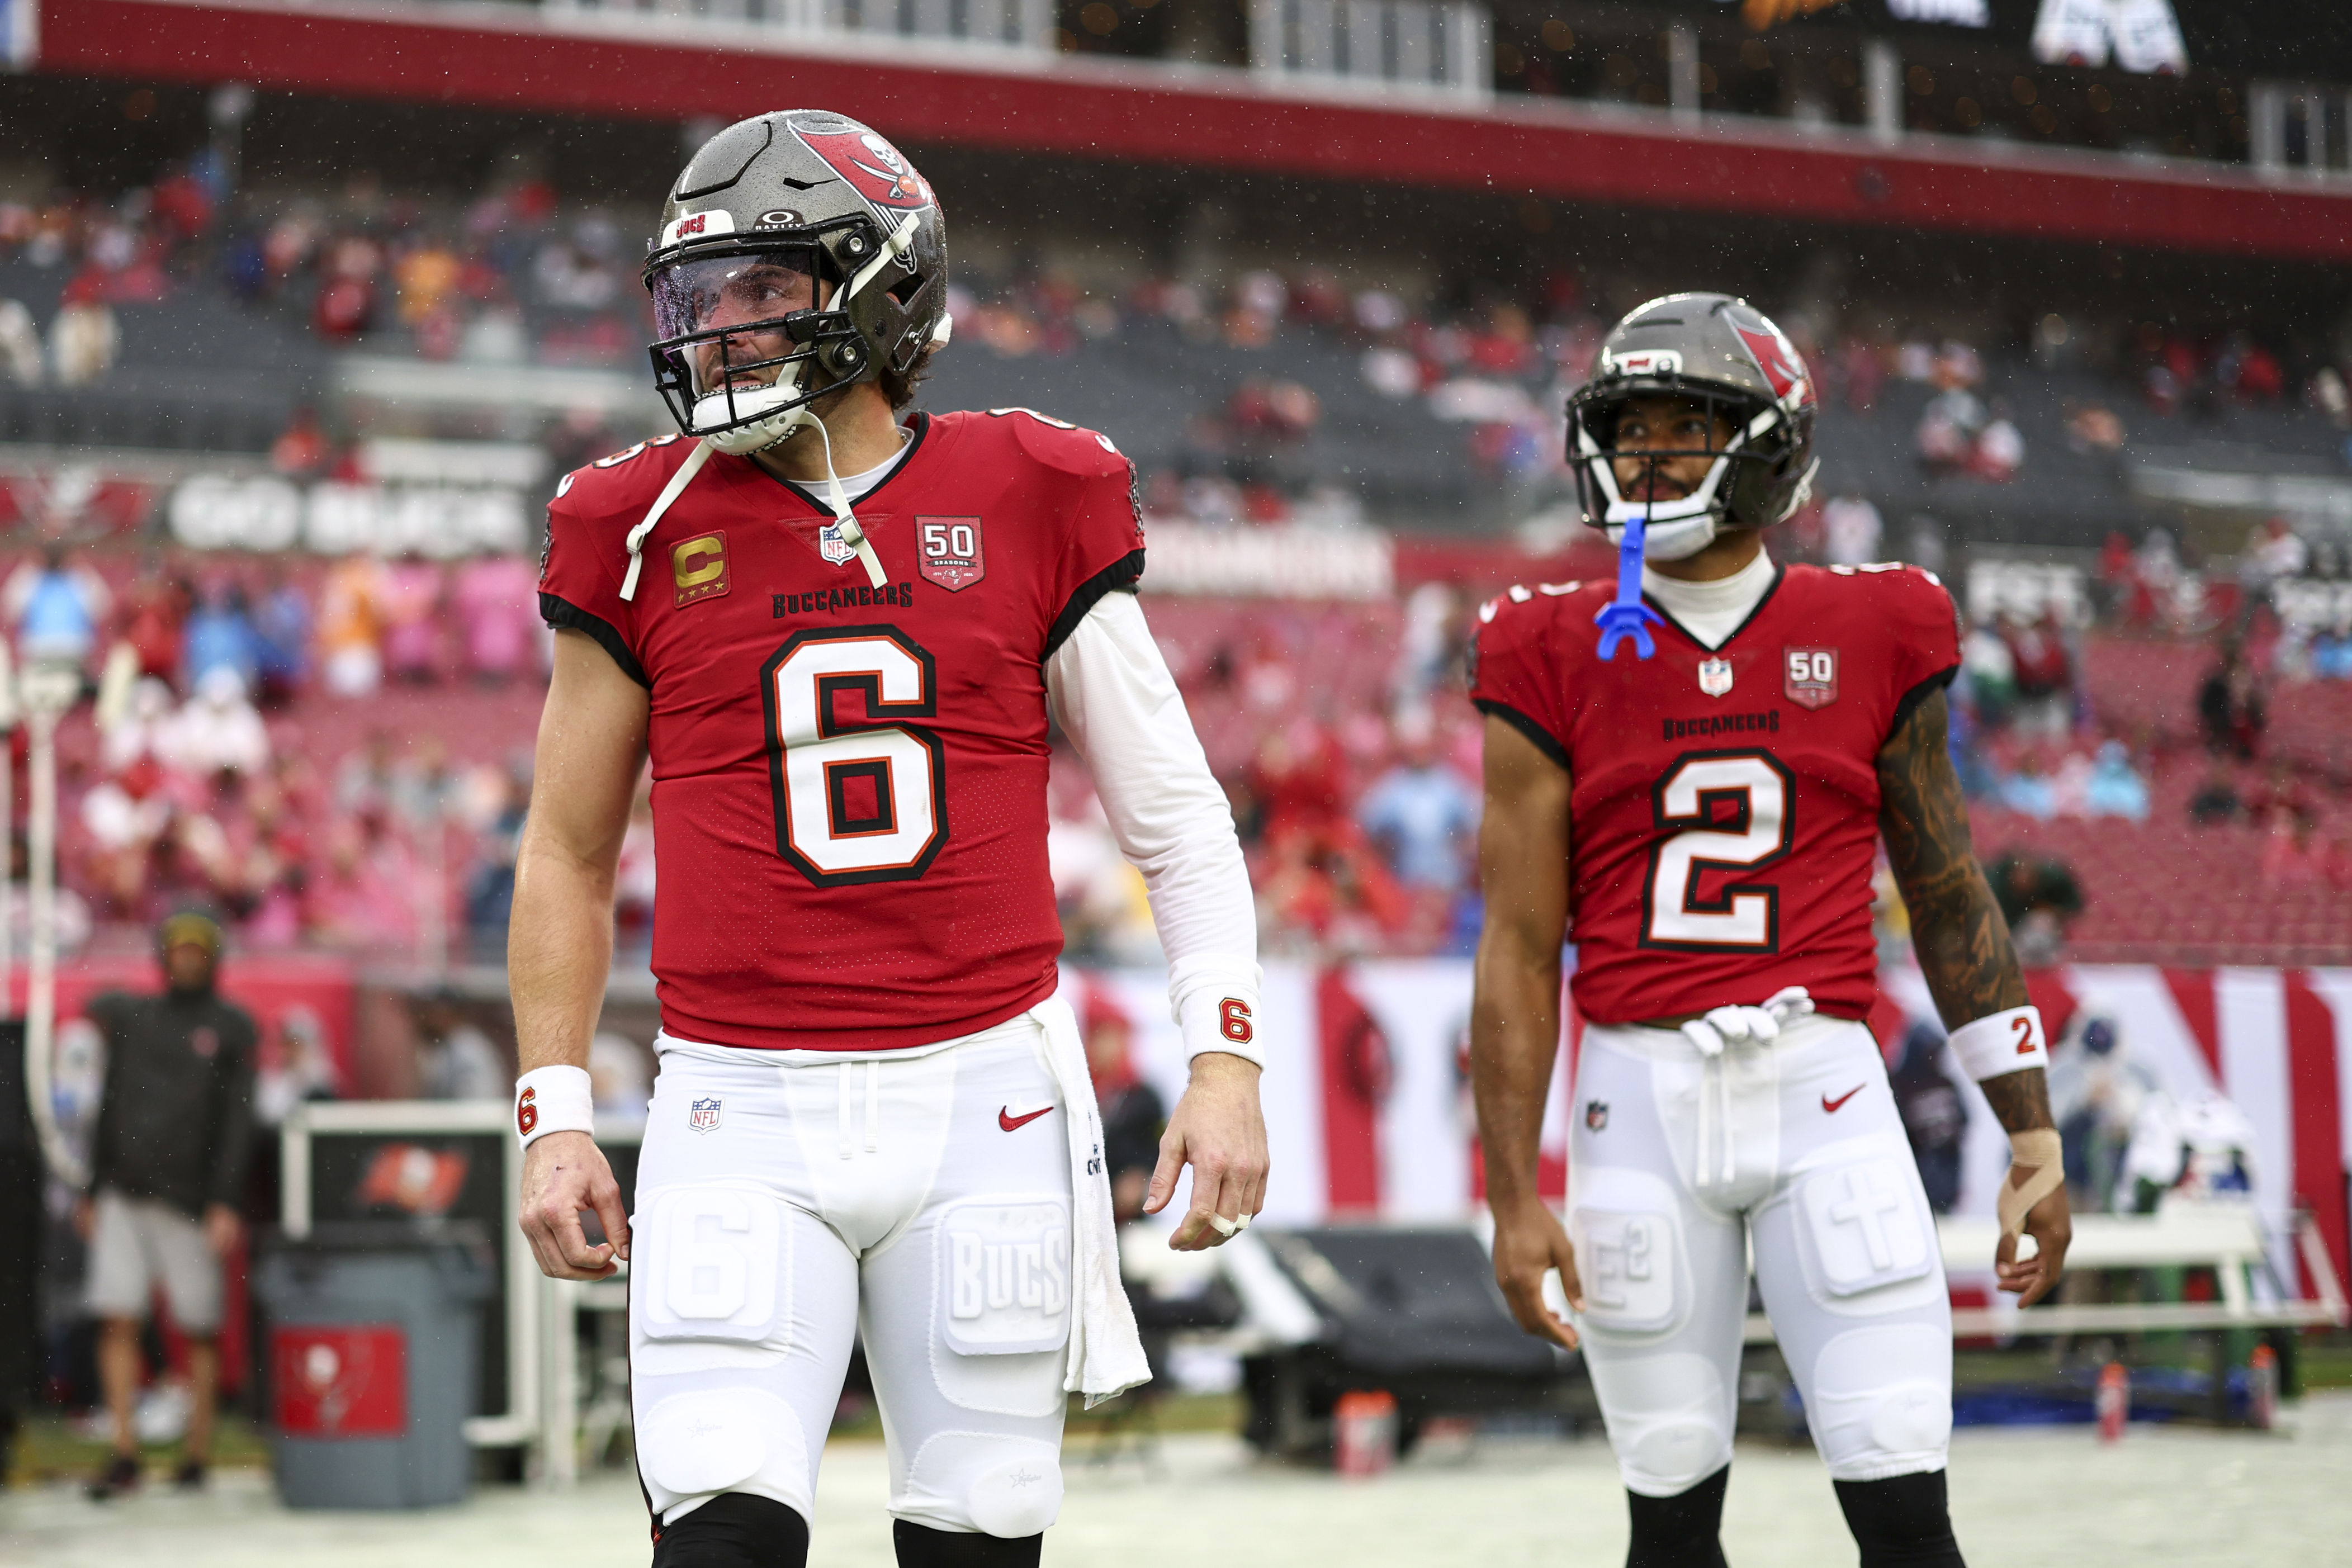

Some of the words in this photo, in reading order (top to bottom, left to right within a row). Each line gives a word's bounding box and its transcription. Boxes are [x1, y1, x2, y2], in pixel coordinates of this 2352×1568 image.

[827, 540, 851, 557] NFL
[924, 524, 975, 558] 50
[674, 537, 724, 589] C
[772, 582, 913, 619] BUCCANEERS
[1789, 651, 1833, 683] 50
[1663, 710, 1780, 742] BUCCANEERS
[760, 623, 950, 888] 6
[1638, 746, 1796, 955] 2
[1219, 997, 1252, 1044] 6
[2012, 1017, 2037, 1054] 2
[518, 1086, 538, 1136] 6
[693, 1111, 716, 1126] NFL
[667, 1190, 750, 1321] 6
[949, 1228, 1066, 1318] BUCS
